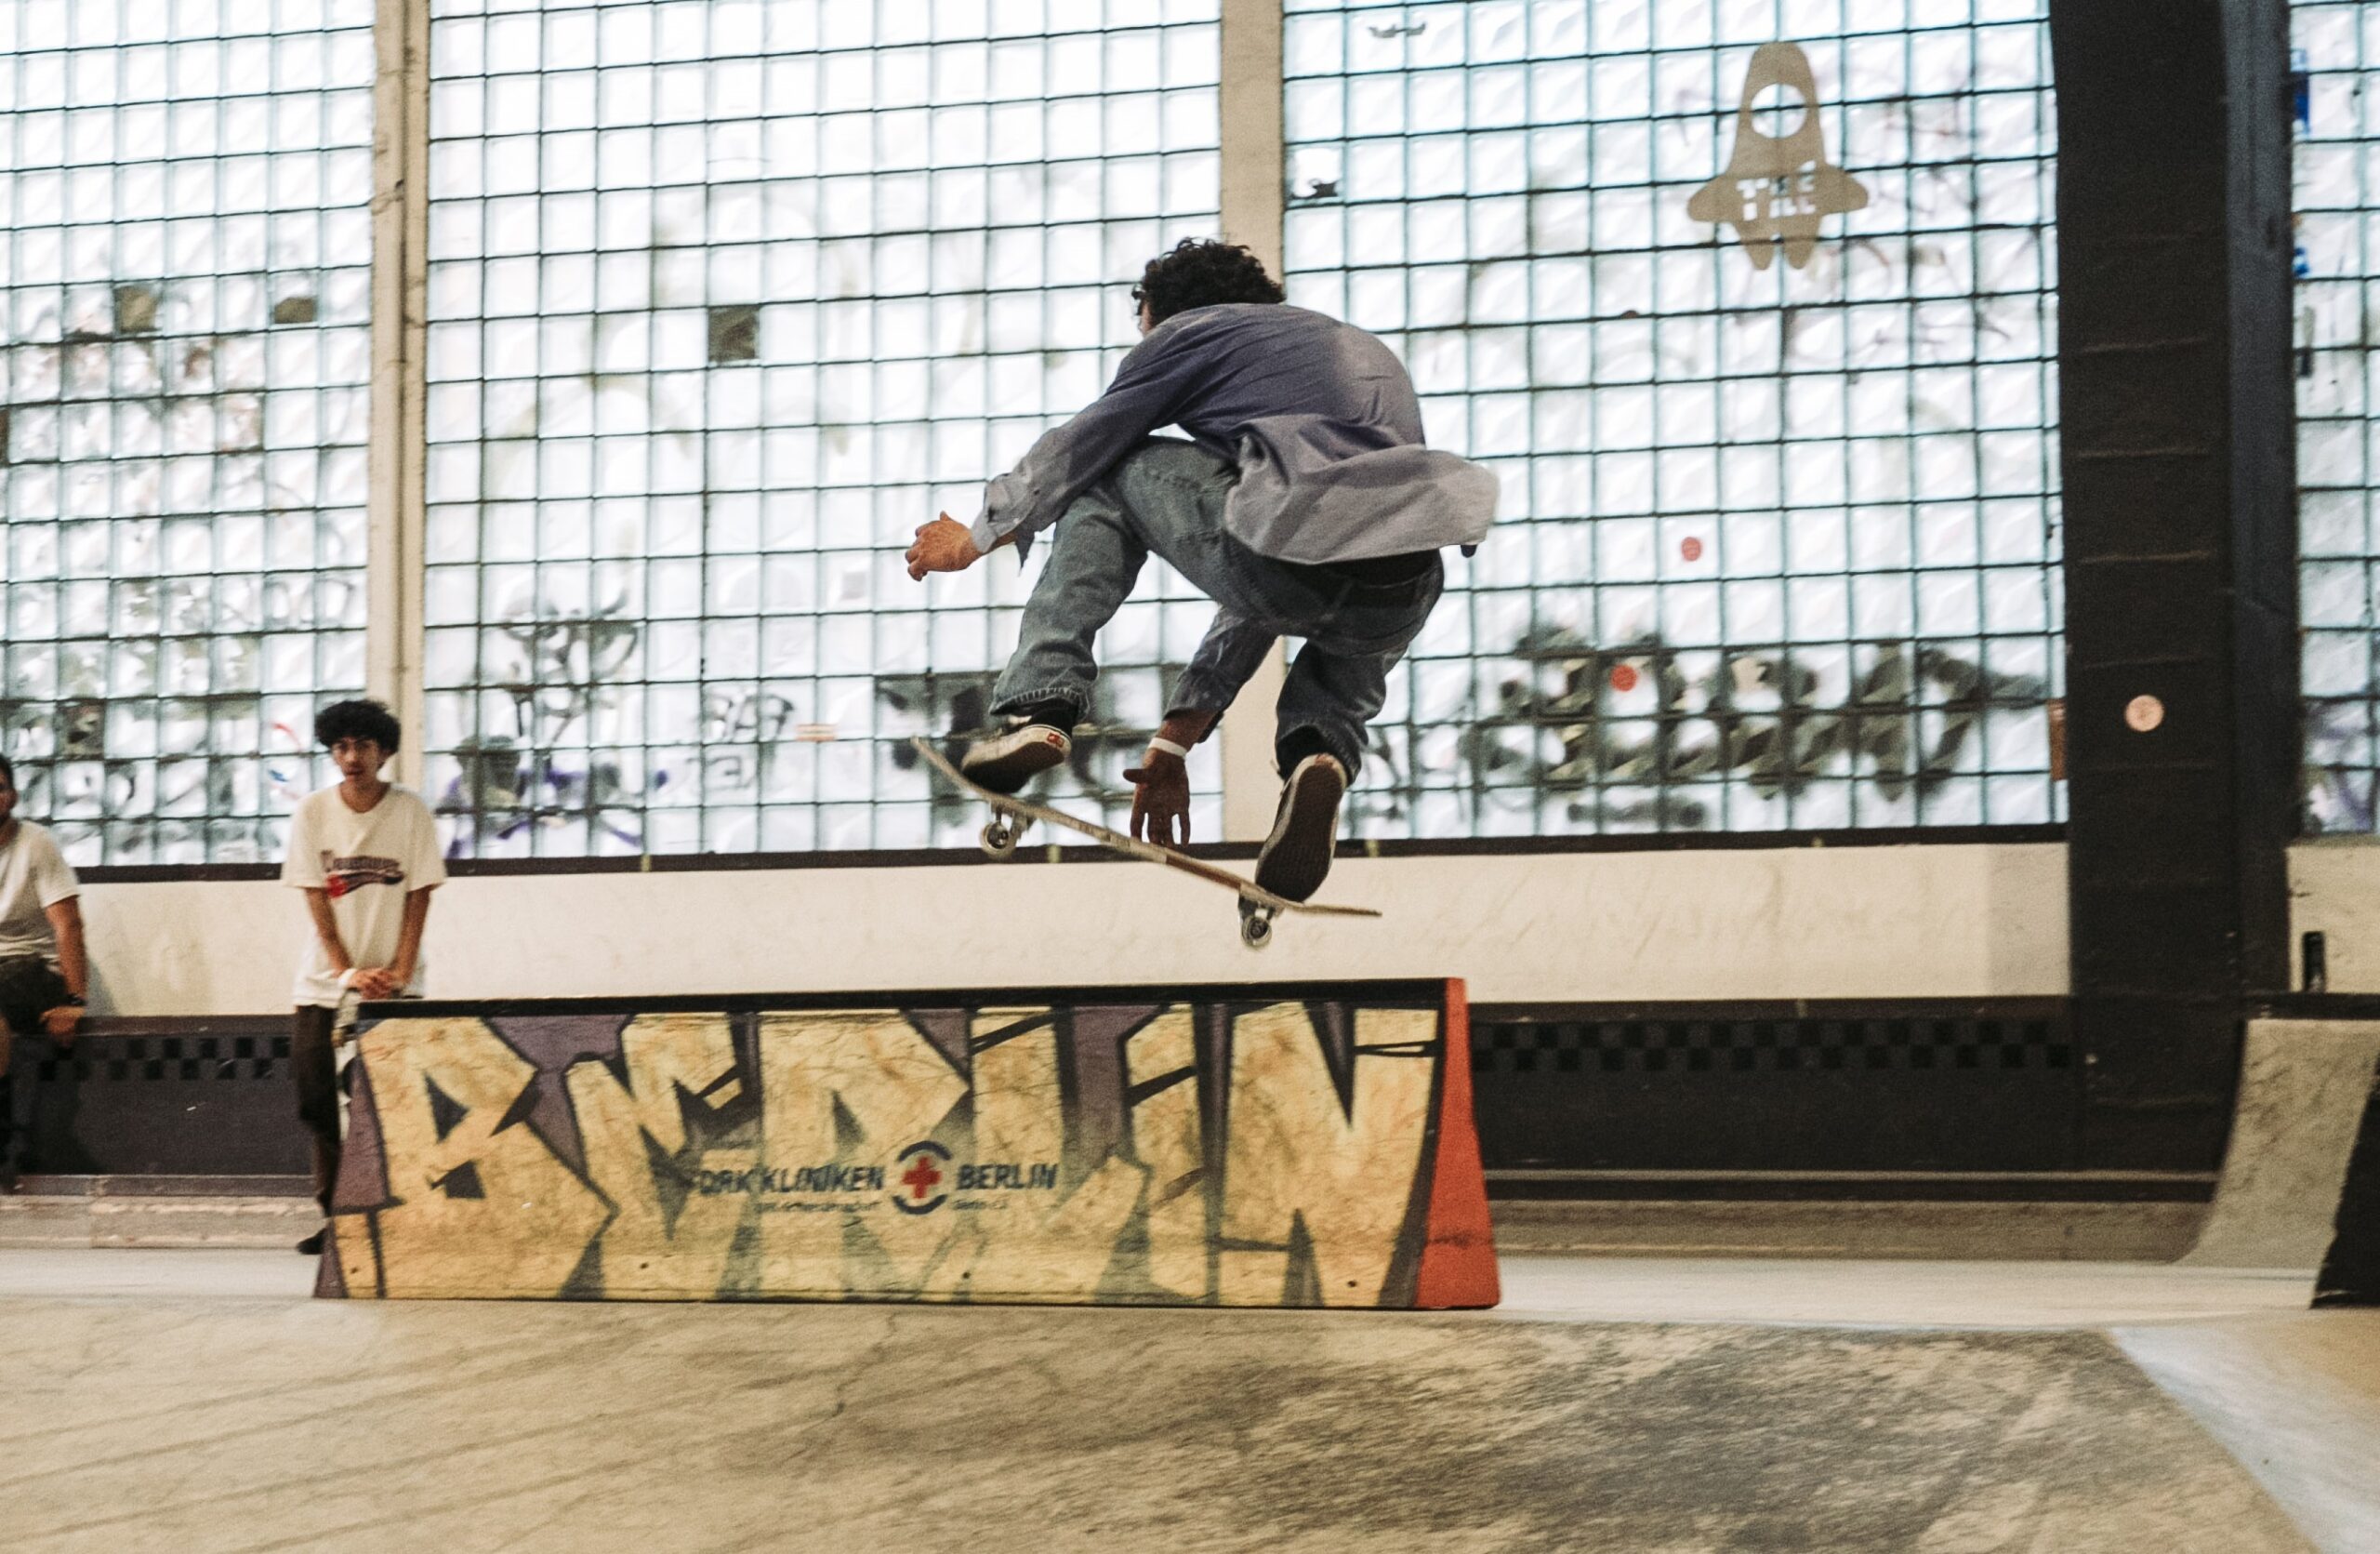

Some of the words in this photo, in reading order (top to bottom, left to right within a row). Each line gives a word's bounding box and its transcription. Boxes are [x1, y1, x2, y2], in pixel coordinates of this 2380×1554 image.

[700, 1169, 751, 1196] DRK
[760, 1164, 884, 1193] KLINIKEN
[956, 1163, 1058, 1190] BERLIN
